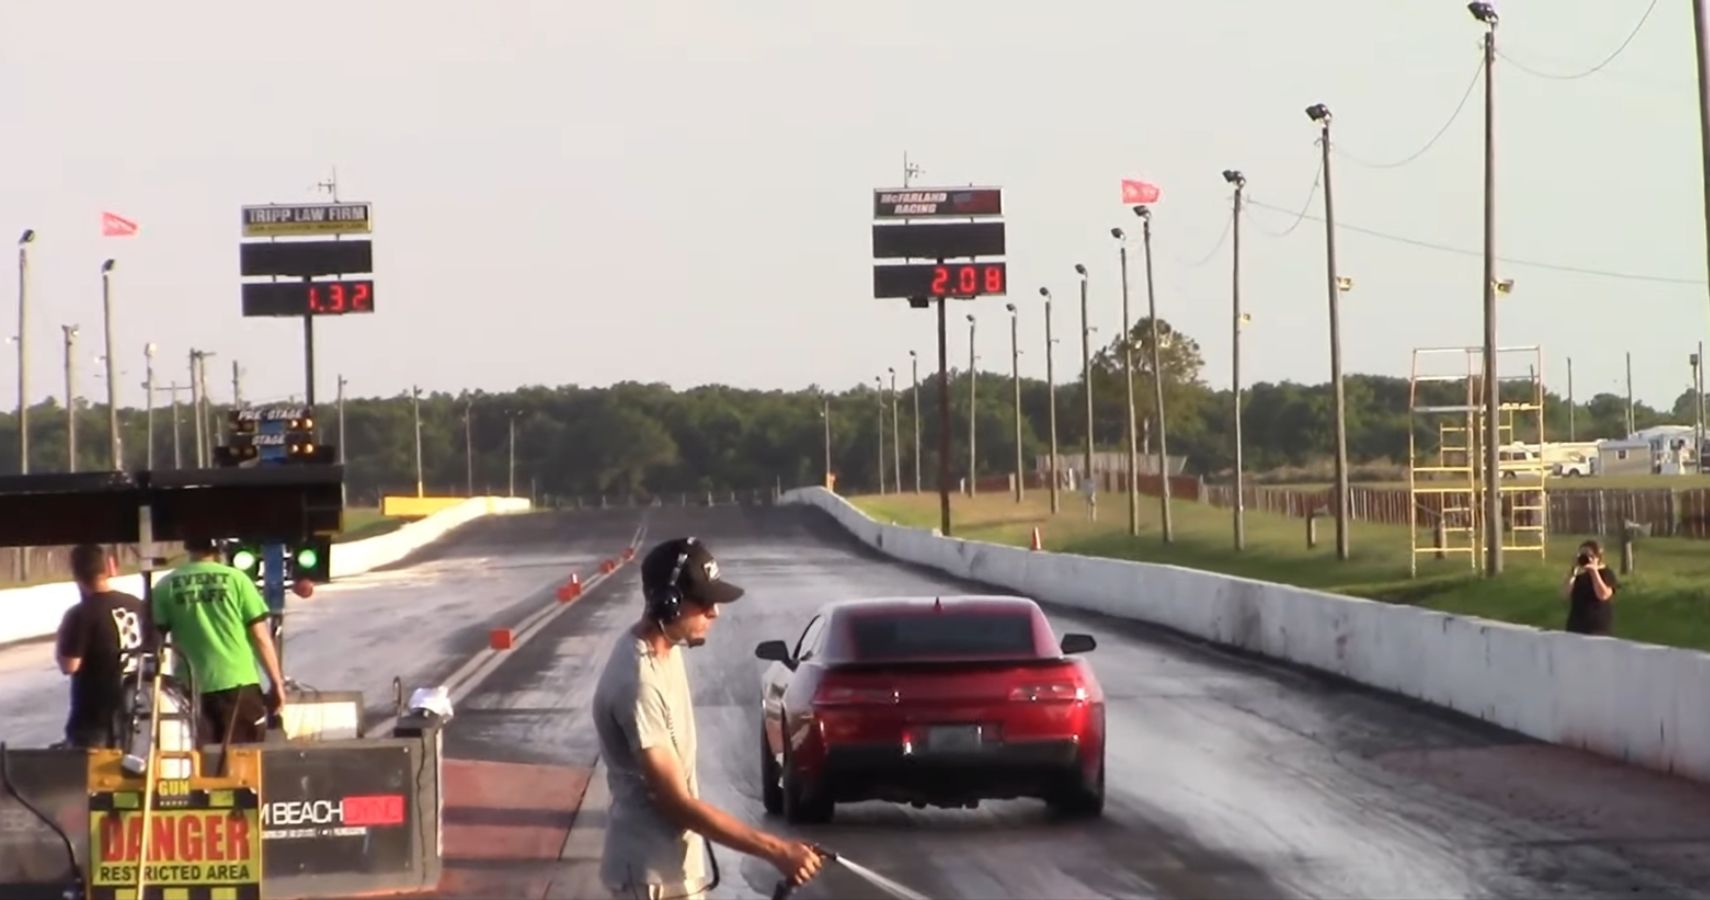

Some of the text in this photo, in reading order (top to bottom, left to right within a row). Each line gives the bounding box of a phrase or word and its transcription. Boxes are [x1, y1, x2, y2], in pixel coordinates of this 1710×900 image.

[249, 205, 366, 222] TRIPP LAW FIRM
[894, 203, 937, 215] RACING
[931, 265, 1002, 294] 2.08
[307, 283, 370, 312] 1.32
[172, 572, 230, 588] EVENT
[174, 589, 228, 605] STAFF
[158, 780, 190, 796] GUN
[272, 800, 343, 825] BEACH
[101, 814, 251, 862] DANGER
[100, 863, 250, 882] RESTRICTED AREA
